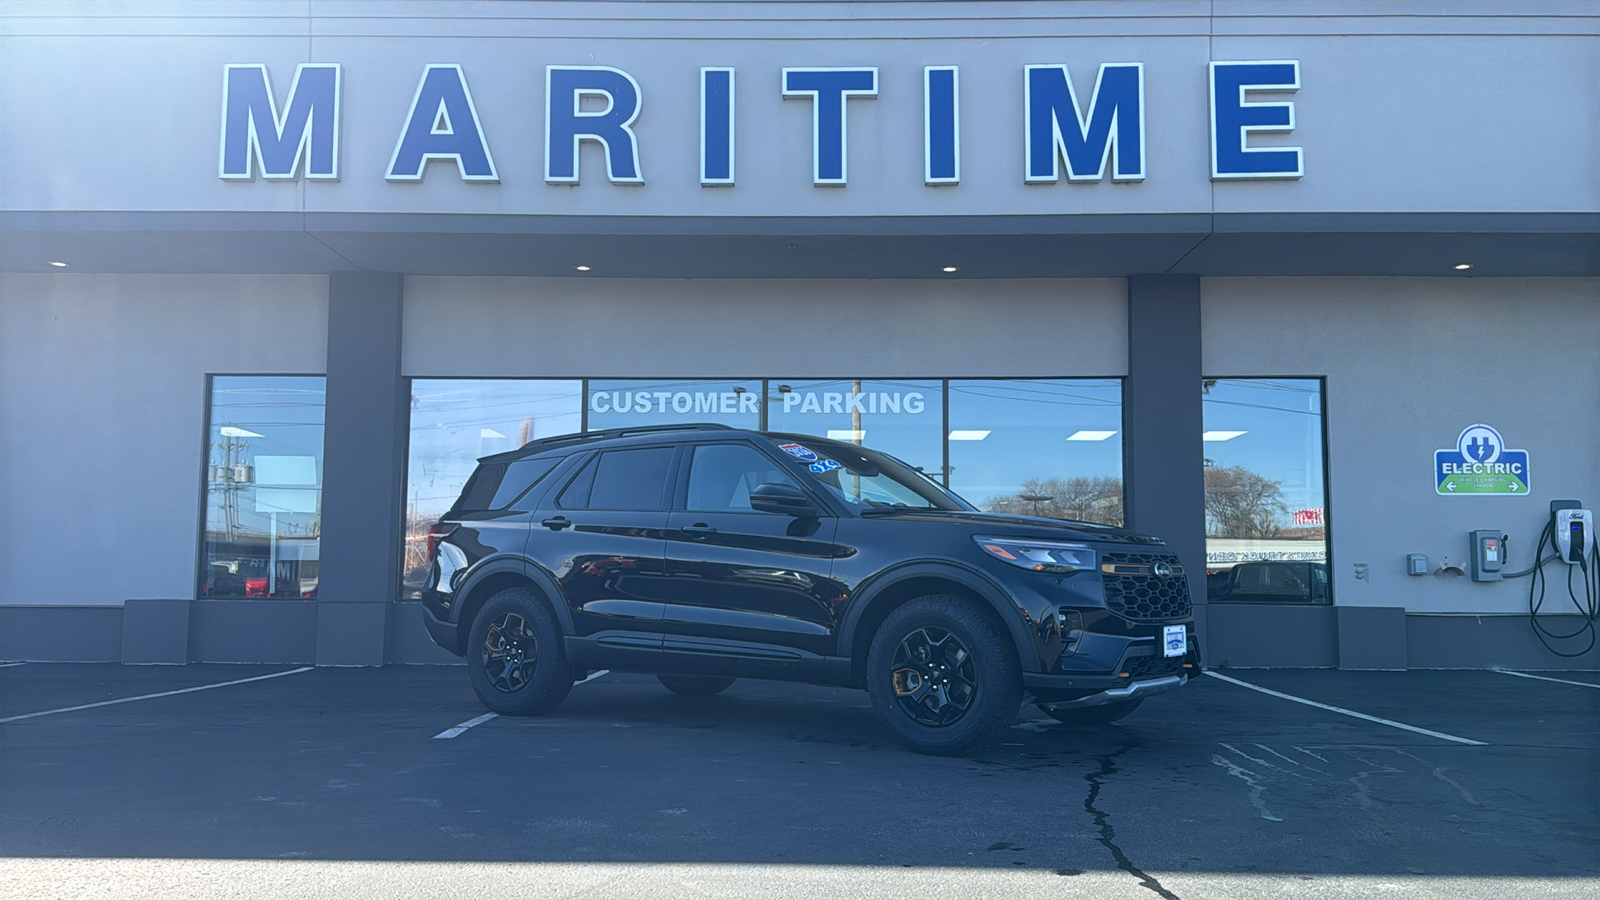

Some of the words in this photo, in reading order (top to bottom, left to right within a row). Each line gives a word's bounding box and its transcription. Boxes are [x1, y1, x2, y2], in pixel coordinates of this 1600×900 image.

[218, 60, 1303, 187] MARITIME
[590, 391, 759, 414] CUSTOMER
[782, 391, 925, 414] PARKING
[1442, 462, 1522, 474] ELECTRIC
